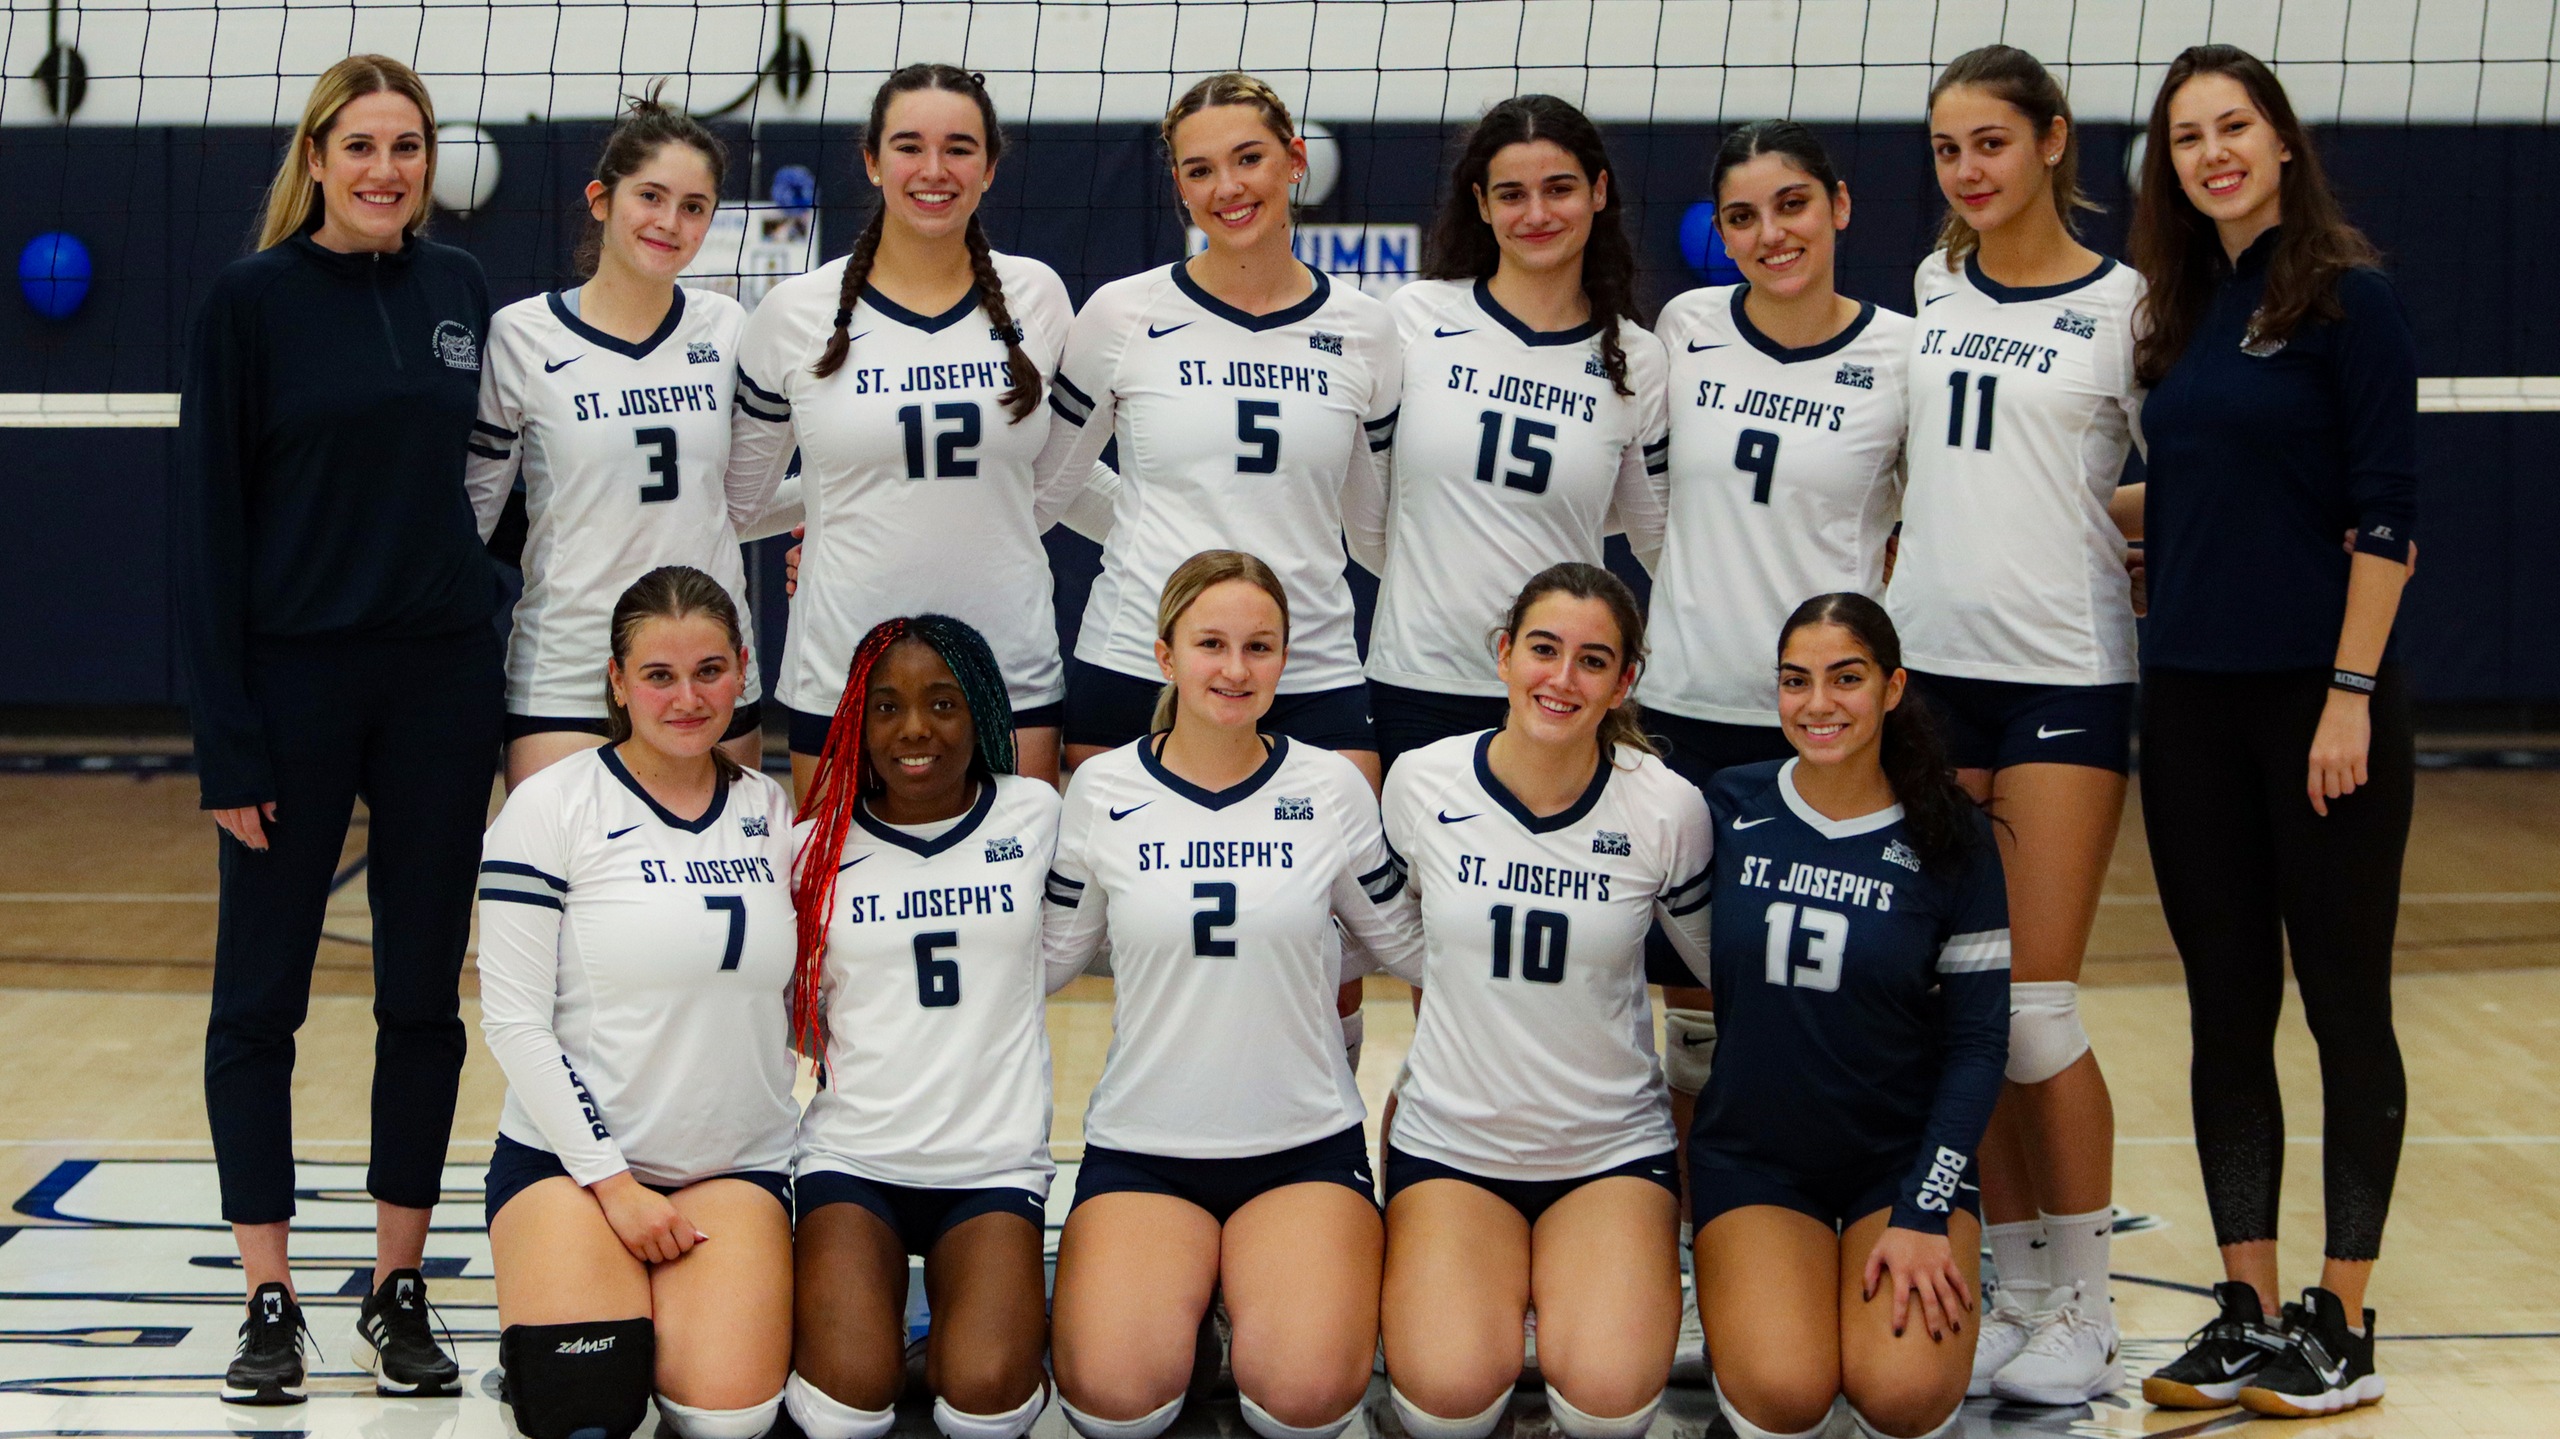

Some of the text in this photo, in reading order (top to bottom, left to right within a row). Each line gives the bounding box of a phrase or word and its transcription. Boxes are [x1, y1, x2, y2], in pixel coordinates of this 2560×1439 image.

[1309, 335, 1343, 356] BEARS
[2053, 316, 2096, 339] BEARS
[687, 348, 719, 364] BEARS
[1921, 330, 2057, 374] ST. JOSEPH'S
[857, 361, 1015, 394] ST. JOSEPH'S
[1180, 361, 1328, 396] ST. JOSEPH'S
[1448, 365, 1597, 423] ST. JOSEPH'S
[1835, 369, 1874, 389] BEARS
[574, 384, 716, 421] ST. JOSEPH'S
[1697, 381, 1845, 432] ST. JOSEPH'S
[1947, 371, 1998, 452] 11
[898, 402, 983, 481] 12
[1235, 400, 1282, 476] 5
[1474, 408, 1559, 495] 15
[635, 427, 681, 505] 3
[1733, 428, 1780, 508] 9
[1275, 805, 1313, 820] BEARS
[985, 845, 1023, 863] BEARS
[1139, 842, 1292, 871] ST. JOSEPH'S
[1592, 838, 1631, 857] BEARS
[1882, 847, 1921, 873] BEARS
[641, 857, 774, 884] ST. JOSEPH'S
[1458, 855, 1610, 902] ST. JOSEPH'S
[1740, 855, 1894, 911] ST. JOSEPH'S
[853, 884, 1013, 923] ST. JOSEPH'S
[1191, 882, 1238, 959] 2
[702, 893, 747, 973] 7
[1490, 904, 1570, 986] 10
[1765, 901, 1849, 992] 13
[911, 929, 962, 1008] 6
